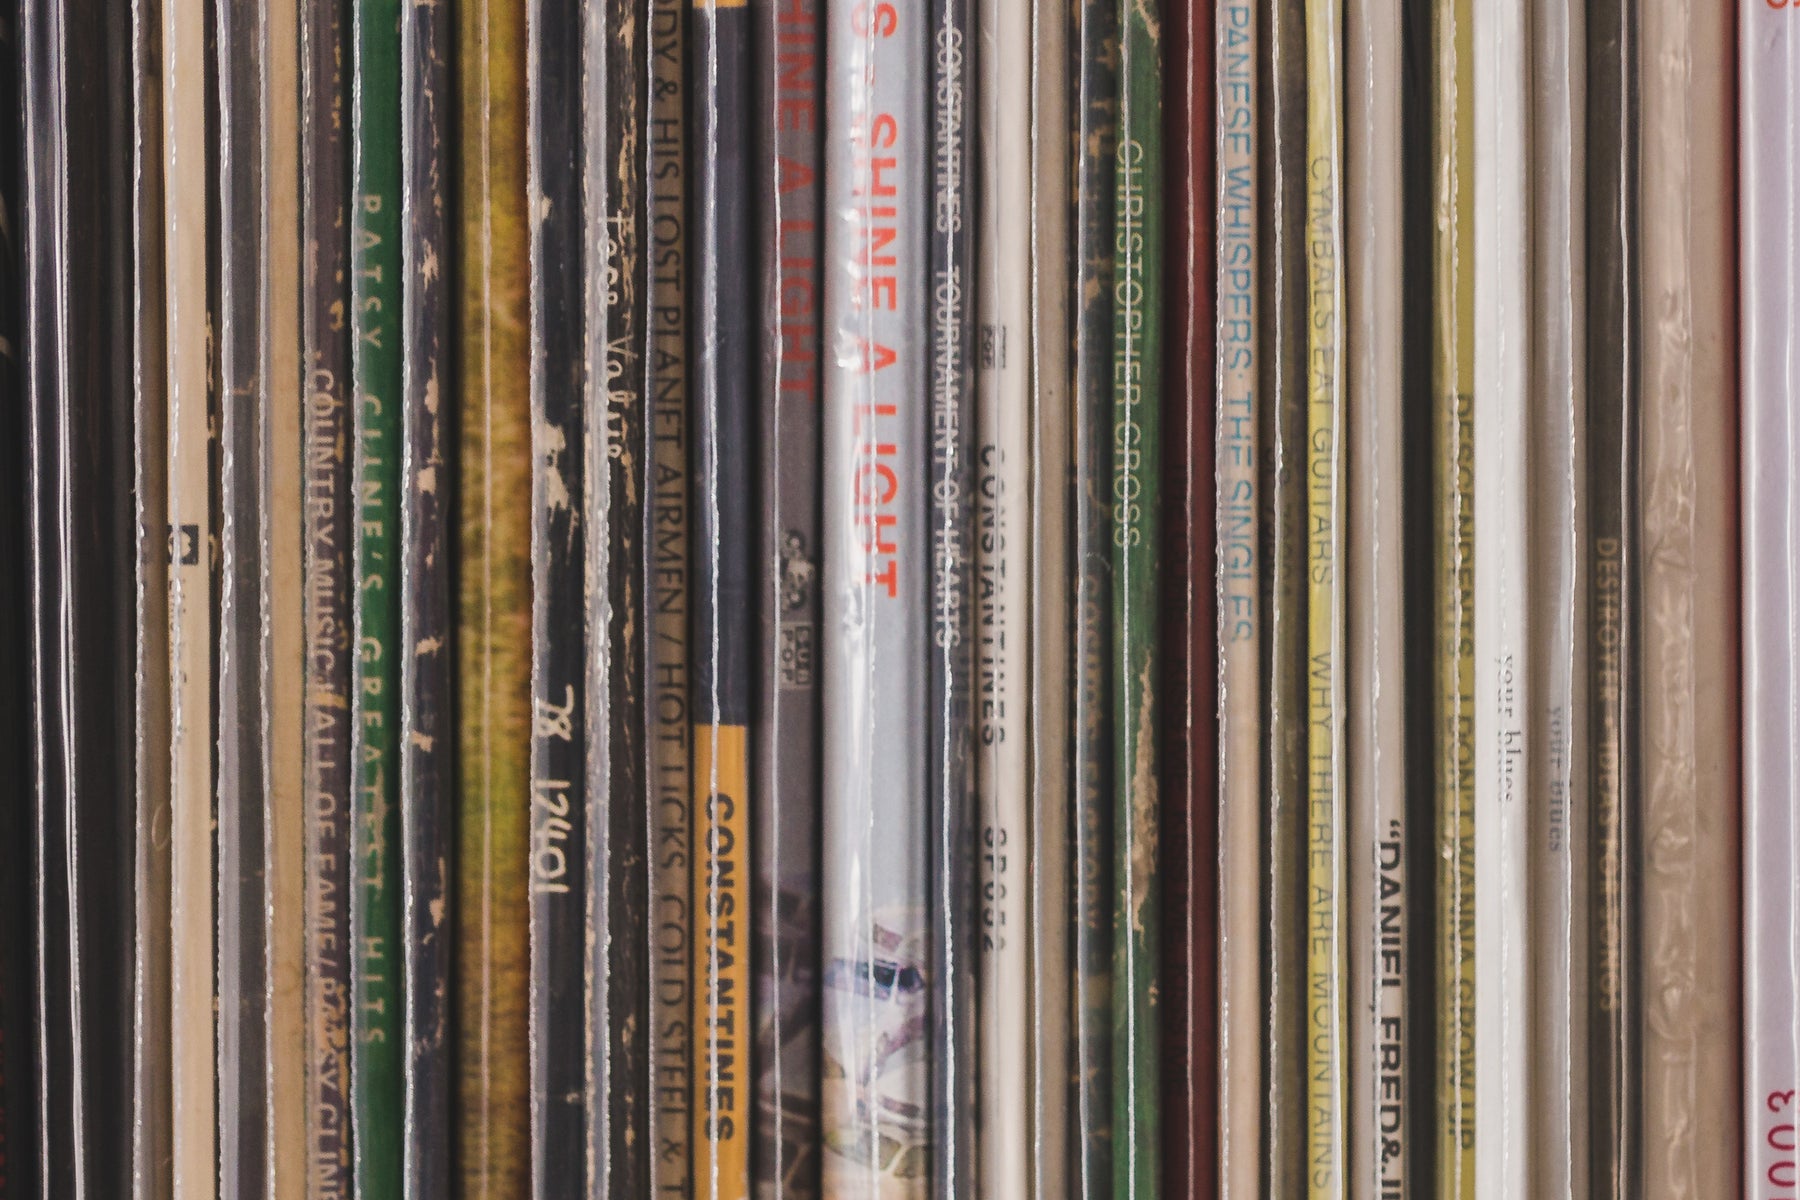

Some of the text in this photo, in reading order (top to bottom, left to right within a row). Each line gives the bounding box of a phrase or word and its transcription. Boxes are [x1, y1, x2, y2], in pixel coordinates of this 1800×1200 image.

[653, 0, 678, 60] DY
[653, 80, 676, 103] &
[654, 117, 678, 181] HIS
[778, 159, 813, 196] A
[654, 194, 680, 300] LOST
[778, 220, 814, 400] LIGHT
[654, 312, 680, 445] PLANET
[852, 112, 898, 599] SHINE A LIGHT
[935, 27, 961, 650] CONSTANTINES TOURNAMENT OF HEARTS
[1113, 140, 1142, 551] CHRISTOPHER CROSS
[309, 370, 335, 547] COUNTRY
[1224, 390, 1252, 466] THE
[309, 560, 336, 670] MUSIC
[654, 462, 682, 621] AIRMEN
[980, 445, 1004, 753] CONSTANTINES
[1226, 479, 1253, 645] SINGLES
[357, 194, 385, 1045] PATSY CLINE'S GREATEST HITS
[780, 630, 793, 683] POP
[1311, 156, 1337, 1191] CYMBALS EAT GUITARS WHY THERE ARE MOUNTAINS
[1595, 537, 1618, 706] DESTROYER
[310, 682, 337, 785] HALL
[656, 662, 683, 740] HOT
[1447, 392, 1475, 1152] DESCENDENTS DON'T WANNA GROW UP
[1494, 655, 1521, 805] your blues
[310, 794, 336, 841] OF
[533, 686, 573, 893] 78 12401
[1546, 705, 1572, 853] your blues
[657, 895, 684, 1009] COLD
[703, 792, 734, 1143] CONSTANTINES
[658, 1021, 684, 1117] STEEL
[660, 1137, 684, 1165] &
